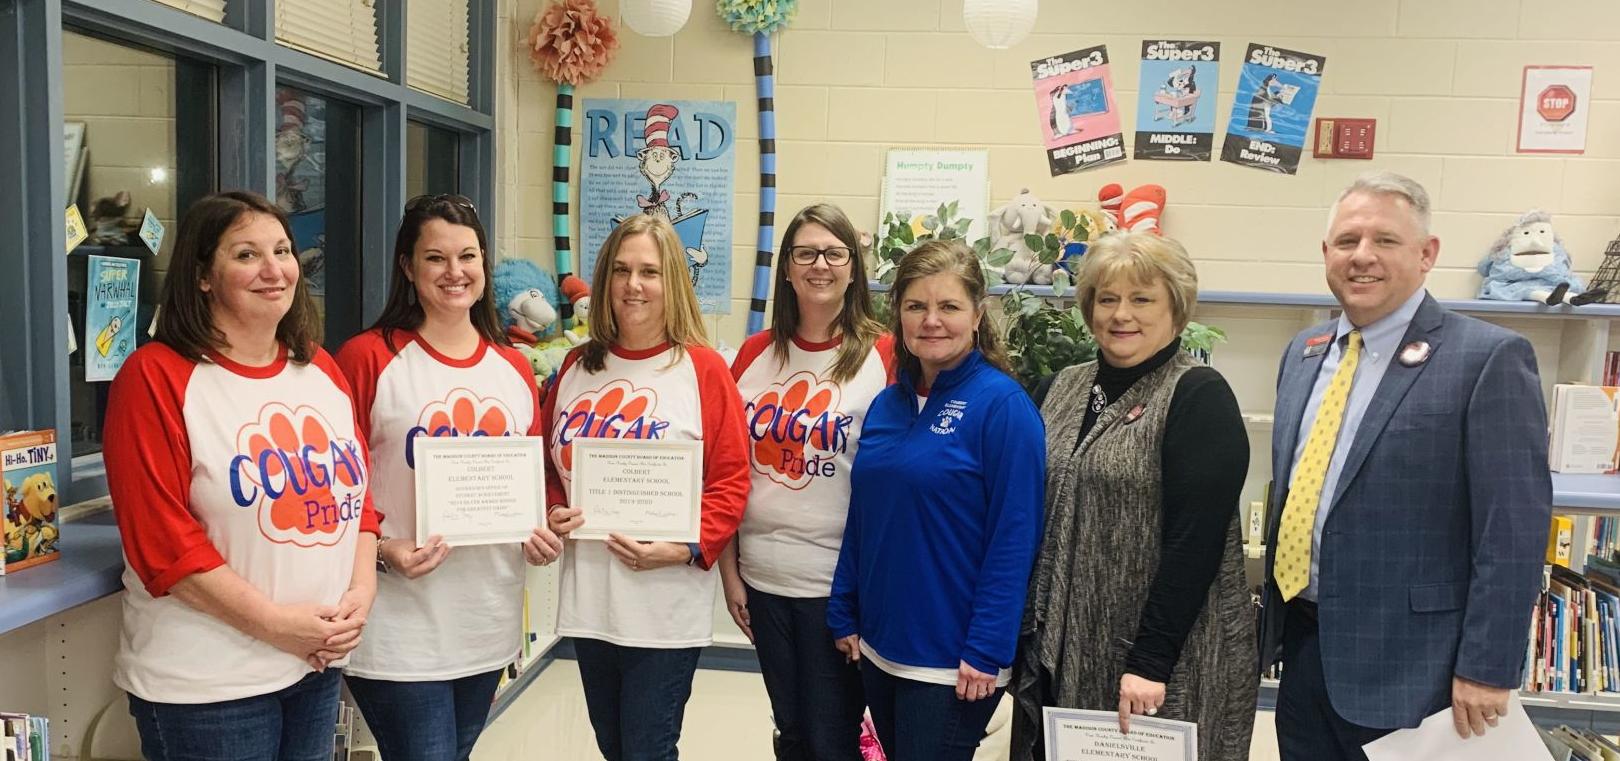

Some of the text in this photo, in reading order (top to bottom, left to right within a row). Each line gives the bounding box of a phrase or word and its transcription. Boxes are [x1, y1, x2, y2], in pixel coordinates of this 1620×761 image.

[1158, 41, 1176, 49] The
[1264, 46, 1281, 57] The
[1146, 45, 1215, 61] Super3
[1036, 51, 1104, 79] Super3
[1046, 57, 1064, 66] The
[1249, 49, 1319, 75] Super3
[1543, 97, 1569, 109] STOP
[586, 108, 733, 161] READ
[1149, 133, 1197, 144] MIDDLE:
[1052, 137, 1120, 159] BEGINNING:
[1164, 144, 1181, 153] Do
[1248, 140, 1276, 154] END:
[1074, 153, 1101, 165] Plan
[1239, 148, 1281, 165] Review
[896, 161, 975, 172] Humpty Dumpty
[100, 270, 128, 281] SUPER
[94, 281, 135, 301] NARWHAL
[781, 449, 836, 478] Pride
[230, 440, 363, 507] COUGAR
[304, 493, 362, 529] Pride
[1094, 740, 1146, 752] DANIELSVILLE
[1081, 748, 1131, 759] ELEMENTARY
